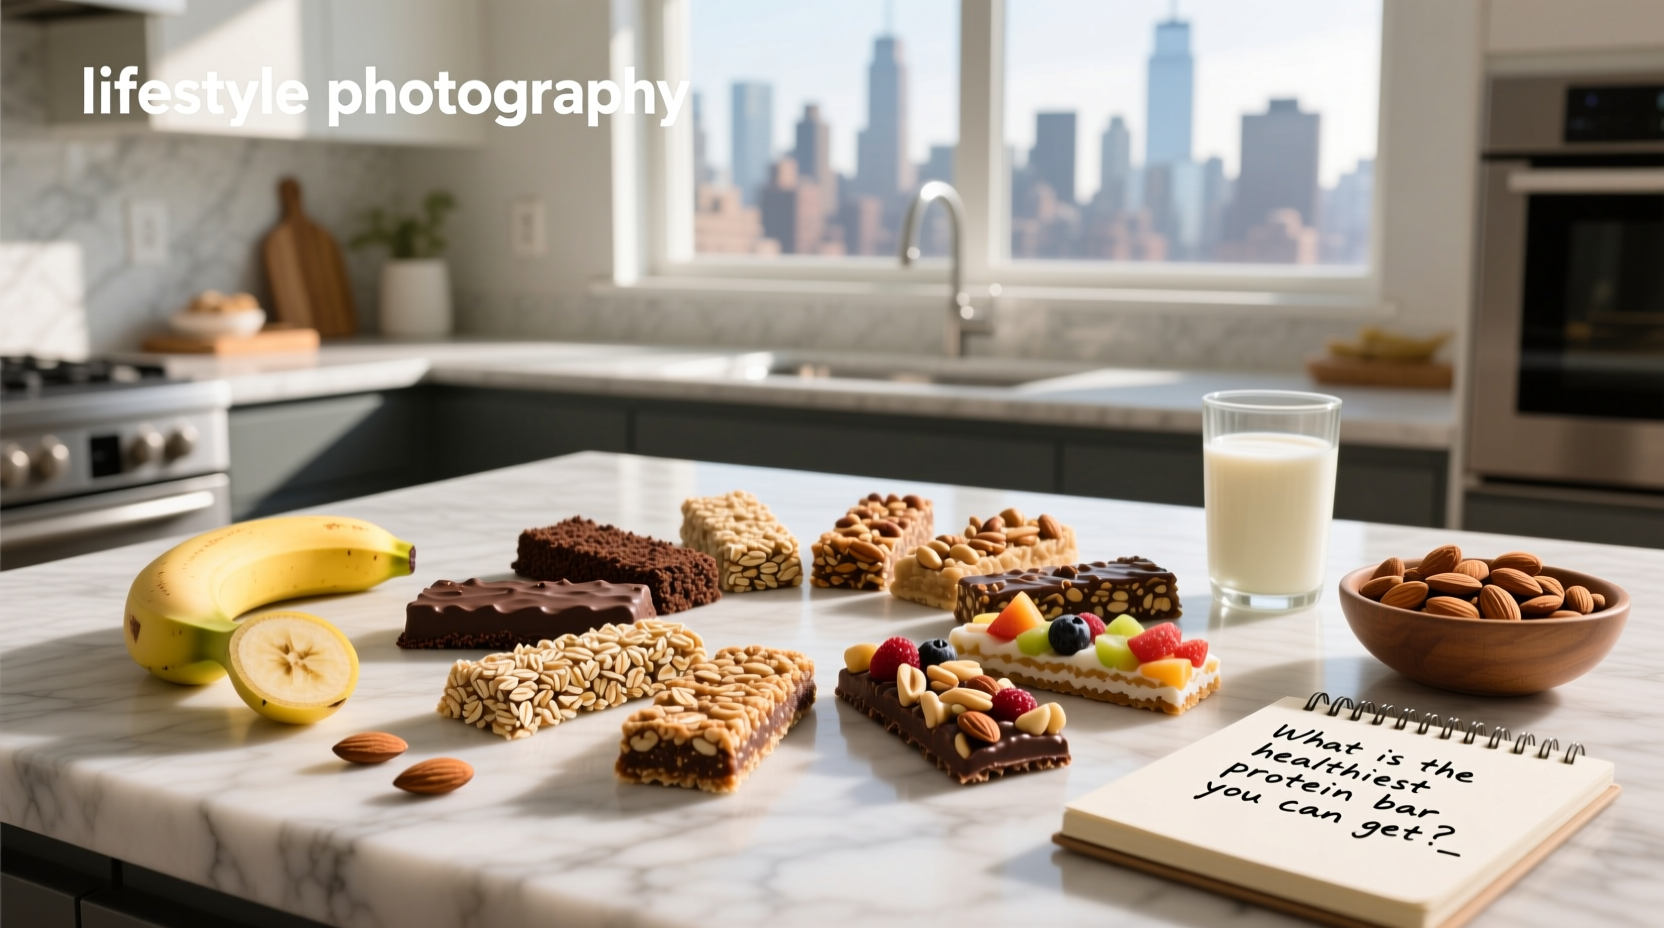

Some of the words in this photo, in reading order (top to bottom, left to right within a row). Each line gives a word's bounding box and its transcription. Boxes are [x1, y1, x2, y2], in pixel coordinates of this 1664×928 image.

[1251, 742, 1431, 794] healthiest
[1272, 723, 1364, 755] What
[1376, 749, 1404, 766] is
[1420, 758, 1474, 783] the
[1193, 780, 1262, 804] you
[1278, 800, 1342, 824] can
[1219, 762, 1353, 802] protein
[1373, 793, 1440, 818] bar
